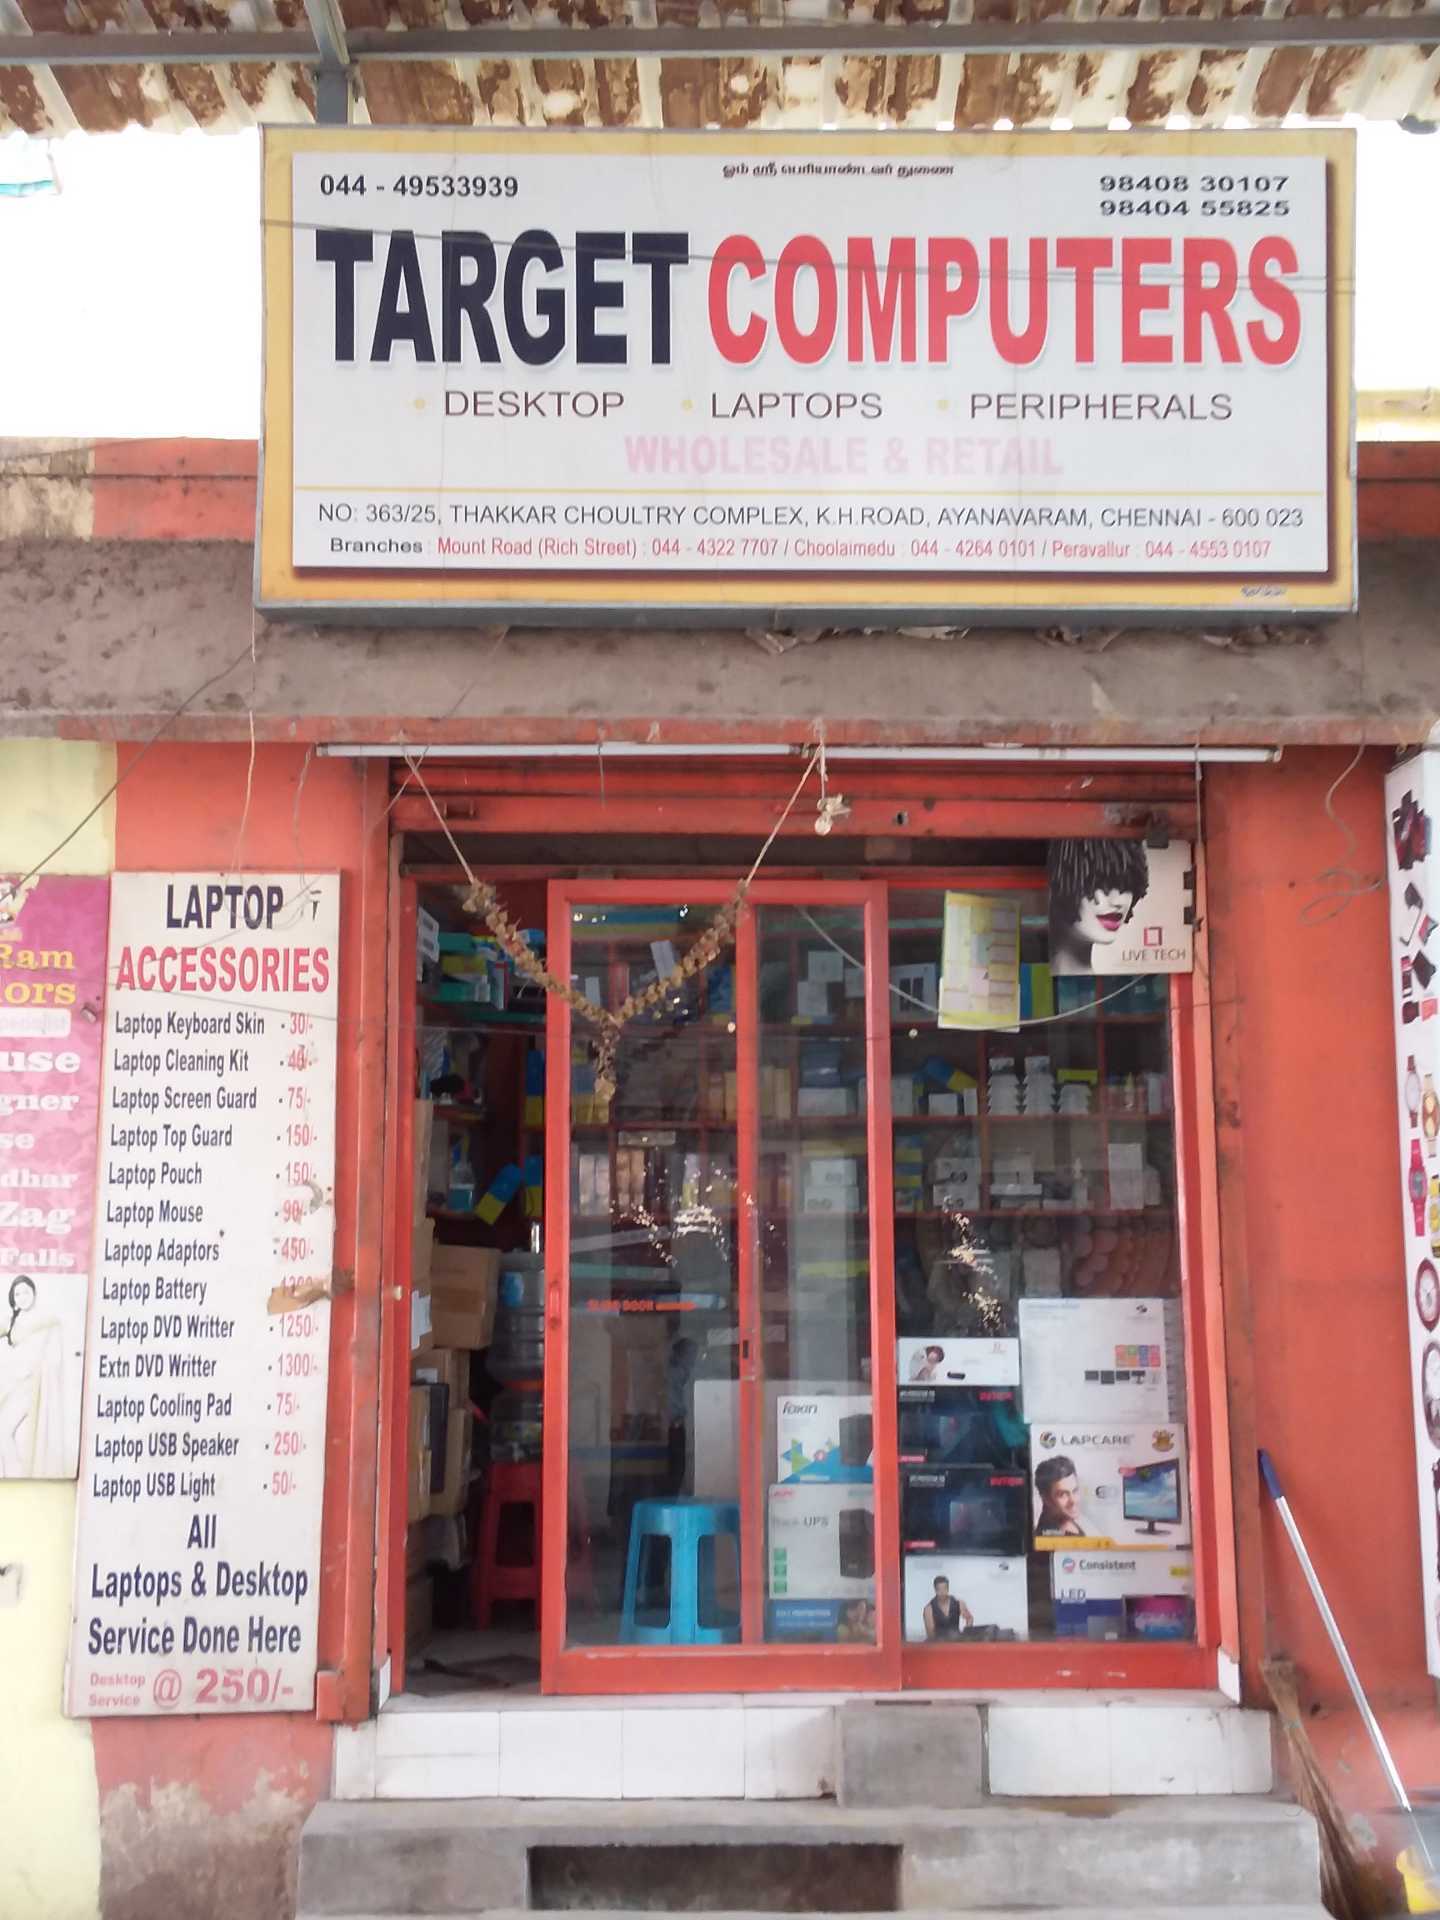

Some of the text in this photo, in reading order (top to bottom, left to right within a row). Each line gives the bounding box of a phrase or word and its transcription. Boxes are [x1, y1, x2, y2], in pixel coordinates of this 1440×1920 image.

[320, 174, 367, 196] 044
[393, 174, 519, 198] 49533939
[1099, 176, 1289, 193] 98408 30107
[1099, 200, 1290, 217] 98404 55825
[315, 228, 1302, 366] TARGET COMPUTERS
[443, 391, 1233, 421] DESKTOP LAPTOPS PERIPHERALS
[624, 434, 1064, 476] WHOLESALE & RETAIL
[366, 504, 442, 526] 363/25,
[450, 504, 556, 524] THAKKAR
[563, 505, 686, 525] CHOULTRY
[693, 506, 808, 528] COMPLEX,
[938, 507, 1093, 529] AYANAVARAM,
[1101, 508, 1201, 528] CHENNAI
[1222, 508, 1259, 528] 600
[1266, 508, 1304, 528] 023
[330, 536, 423, 553] Branches
[437, 537, 485, 555] Mount
[491, 537, 533, 556] Road
[538, 537, 578, 560] (Rich
[584, 537, 637, 560] Street)
[652, 538, 680, 557] 044
[699, 538, 735, 557] 4322
[741, 538, 778, 557] 7707
[794, 538, 896, 558] Choolaimedu
[910, 539, 939, 558] 044
[955, 539, 993, 558] 4264
[999, 539, 1036, 558] 0101
[1052, 540, 1131, 558] Peravallur
[1145, 541, 1173, 558] 044
[1190, 541, 1228, 558] 4553
[1233, 541, 1271, 558] 0107
[165, 884, 284, 929] LAPTOP
[1122, 948, 1186, 961] LIVE TECH
[115, 945, 330, 993] ACCESSORIES
[0, 981, 77, 1005] ors
[115, 1011, 162, 1038] Laptop
[167, 1012, 232, 1039] Keyboard
[235, 1011, 265, 1035] Skin
[113, 1049, 161, 1074] Laptop
[165, 1048, 225, 1076] Cleaning
[229, 1049, 249, 1072] Kit
[112, 1086, 160, 1112] Laptop
[164, 1086, 213, 1110] Screen
[216, 1085, 257, 1110] Guard
[110, 1123, 158, 1149] Laptop
[163, 1124, 189, 1149] Top
[191, 1123, 233, 1147] Guard
[108, 1161, 157, 1189] Laptop
[160, 1161, 203, 1185] Pouch
[106, 1199, 155, 1228] Laptop
[159, 1200, 204, 1223] Mouse
[104, 1238, 152, 1266] Laptop
[156, 1238, 220, 1266] Adaptors
[102, 1276, 151, 1304] Laptop
[155, 1276, 208, 1307] Battery
[100, 1314, 149, 1343] Laptop
[153, 1315, 183, 1339] DVD
[188, 1314, 235, 1339] Writter
[99, 1355, 131, 1379] Extn
[135, 1355, 164, 1378] DVD
[168, 1354, 217, 1378] Writter
[97, 1394, 145, 1422] Laptop
[149, 1393, 202, 1422] Cooling
[206, 1393, 233, 1417] Pad
[95, 1434, 143, 1462] Laptop
[148, 1433, 178, 1457] USB
[182, 1433, 239, 1461] Speaker
[1061, 1434, 1132, 1447] LAPCARE
[93, 1473, 142, 1502] Laptop
[146, 1473, 176, 1497] USB
[180, 1473, 216, 1502] Light
[187, 1514, 217, 1549] All
[1078, 1559, 1136, 1571] Consistent
[91, 1561, 309, 1607] Laptops & Desktop
[88, 1616, 301, 1655] Service Done Here
[89, 1693, 140, 1707] Service
[90, 1668, 294, 1709] Desktop @ 250/-
